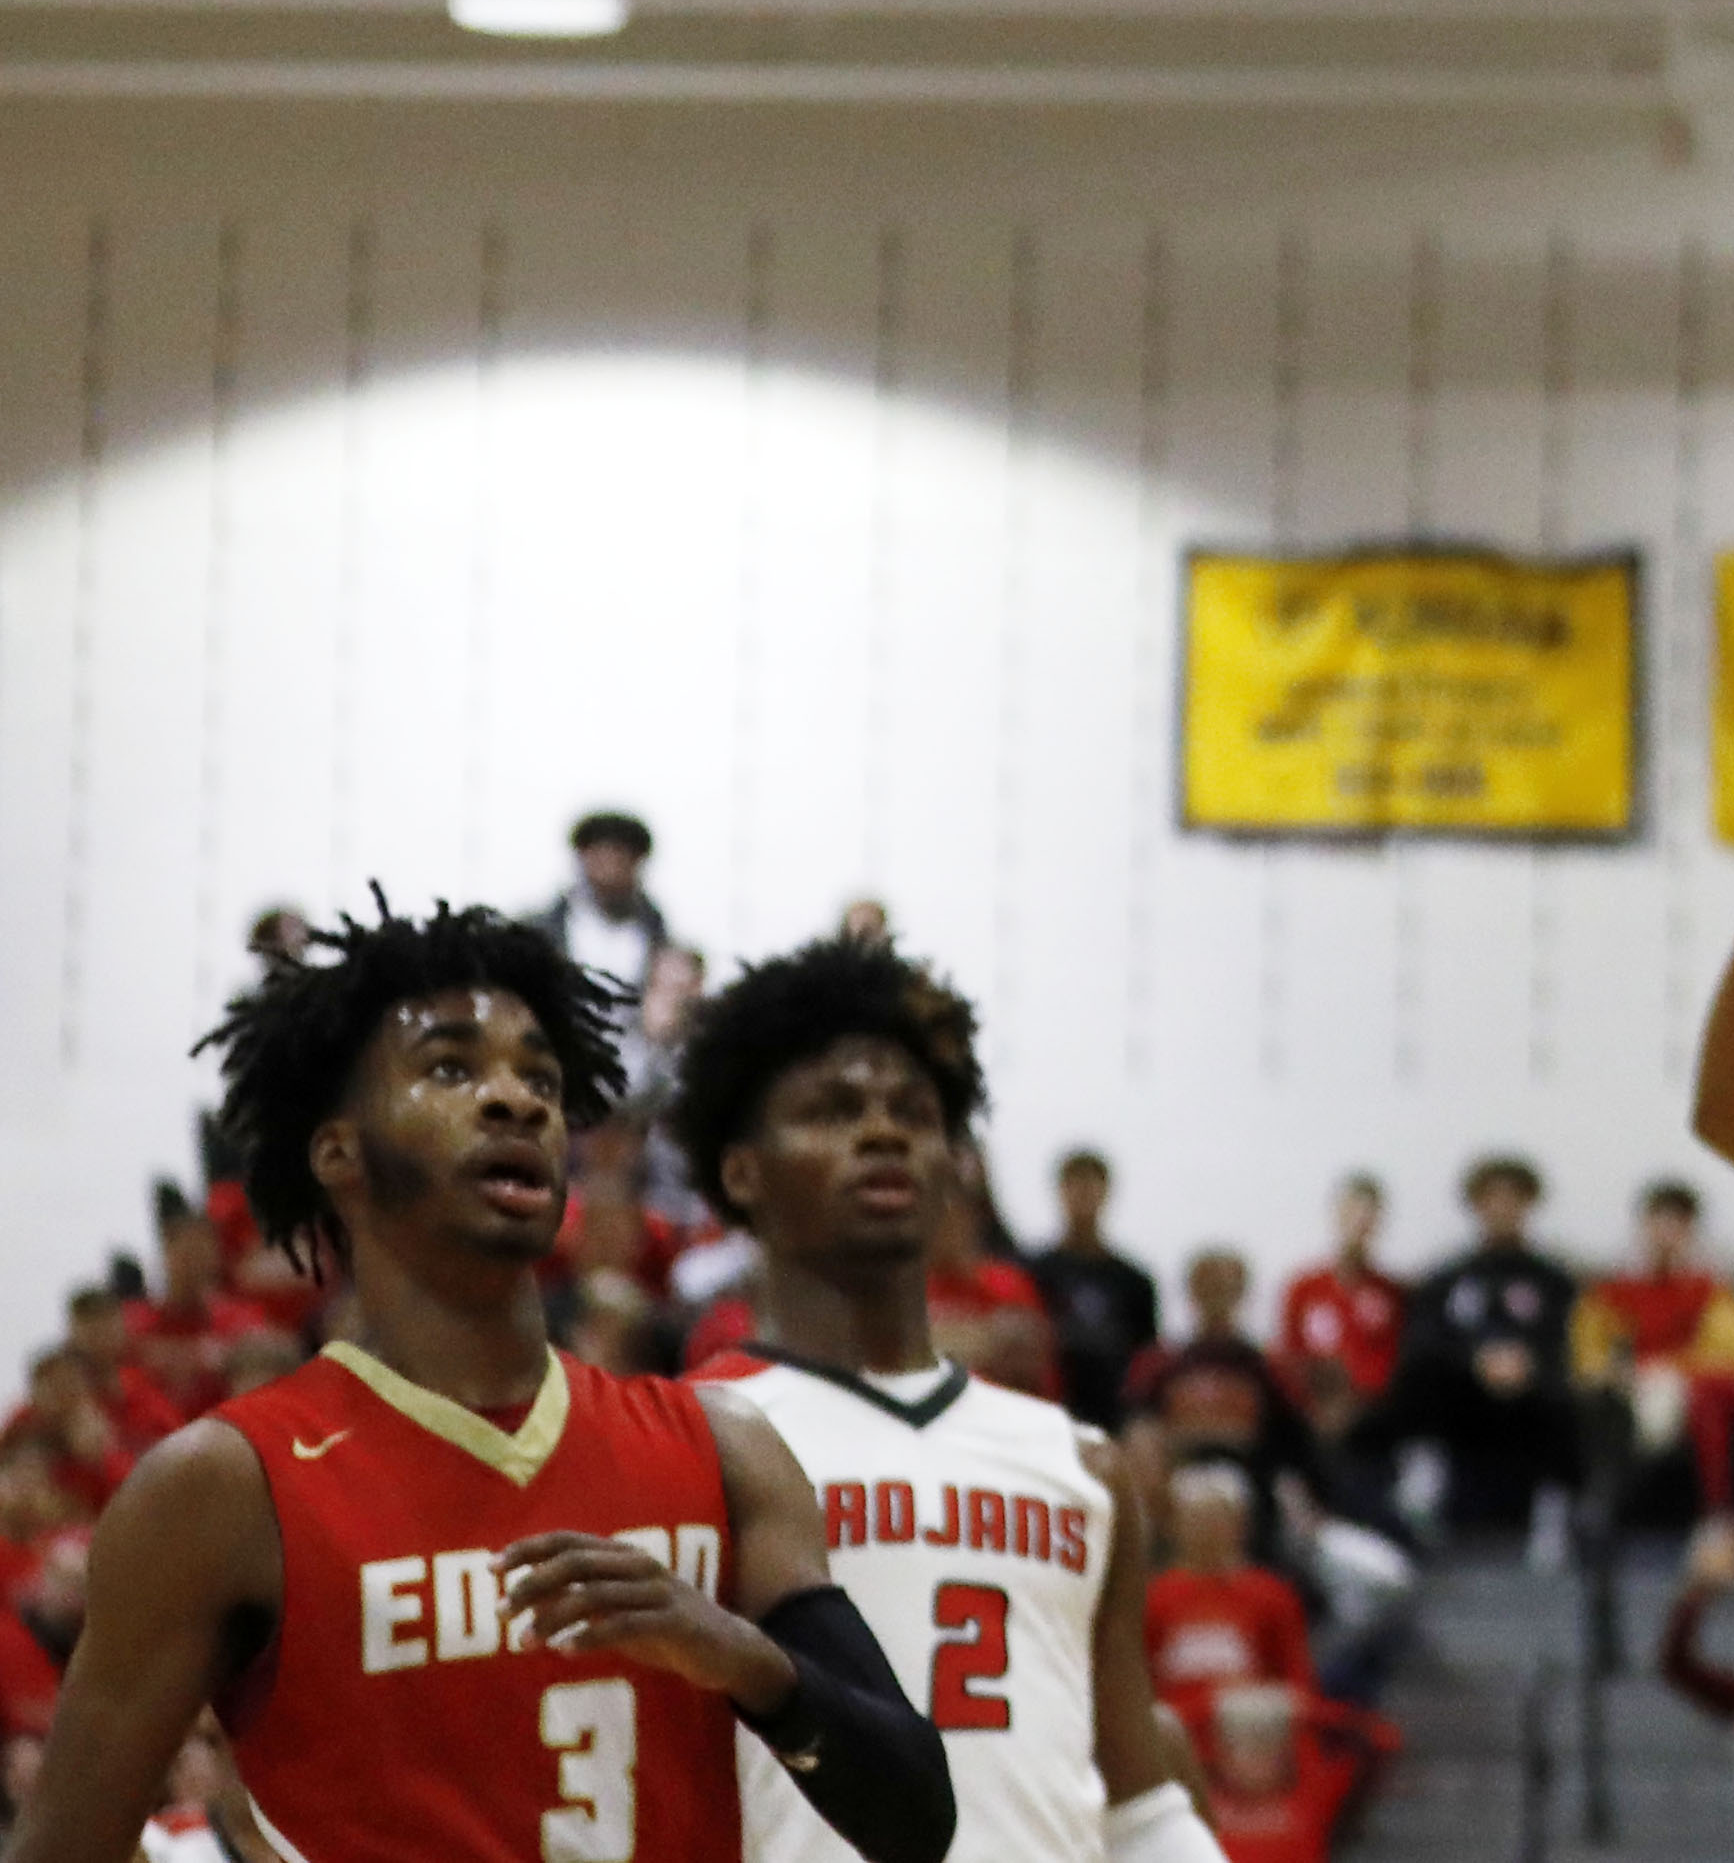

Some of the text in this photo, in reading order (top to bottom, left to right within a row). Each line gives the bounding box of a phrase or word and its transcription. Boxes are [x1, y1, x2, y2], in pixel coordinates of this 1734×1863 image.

[824, 1480, 1088, 1575] ROJANS
[930, 1580, 1011, 1731] 2
[539, 1677, 637, 1863] 3
